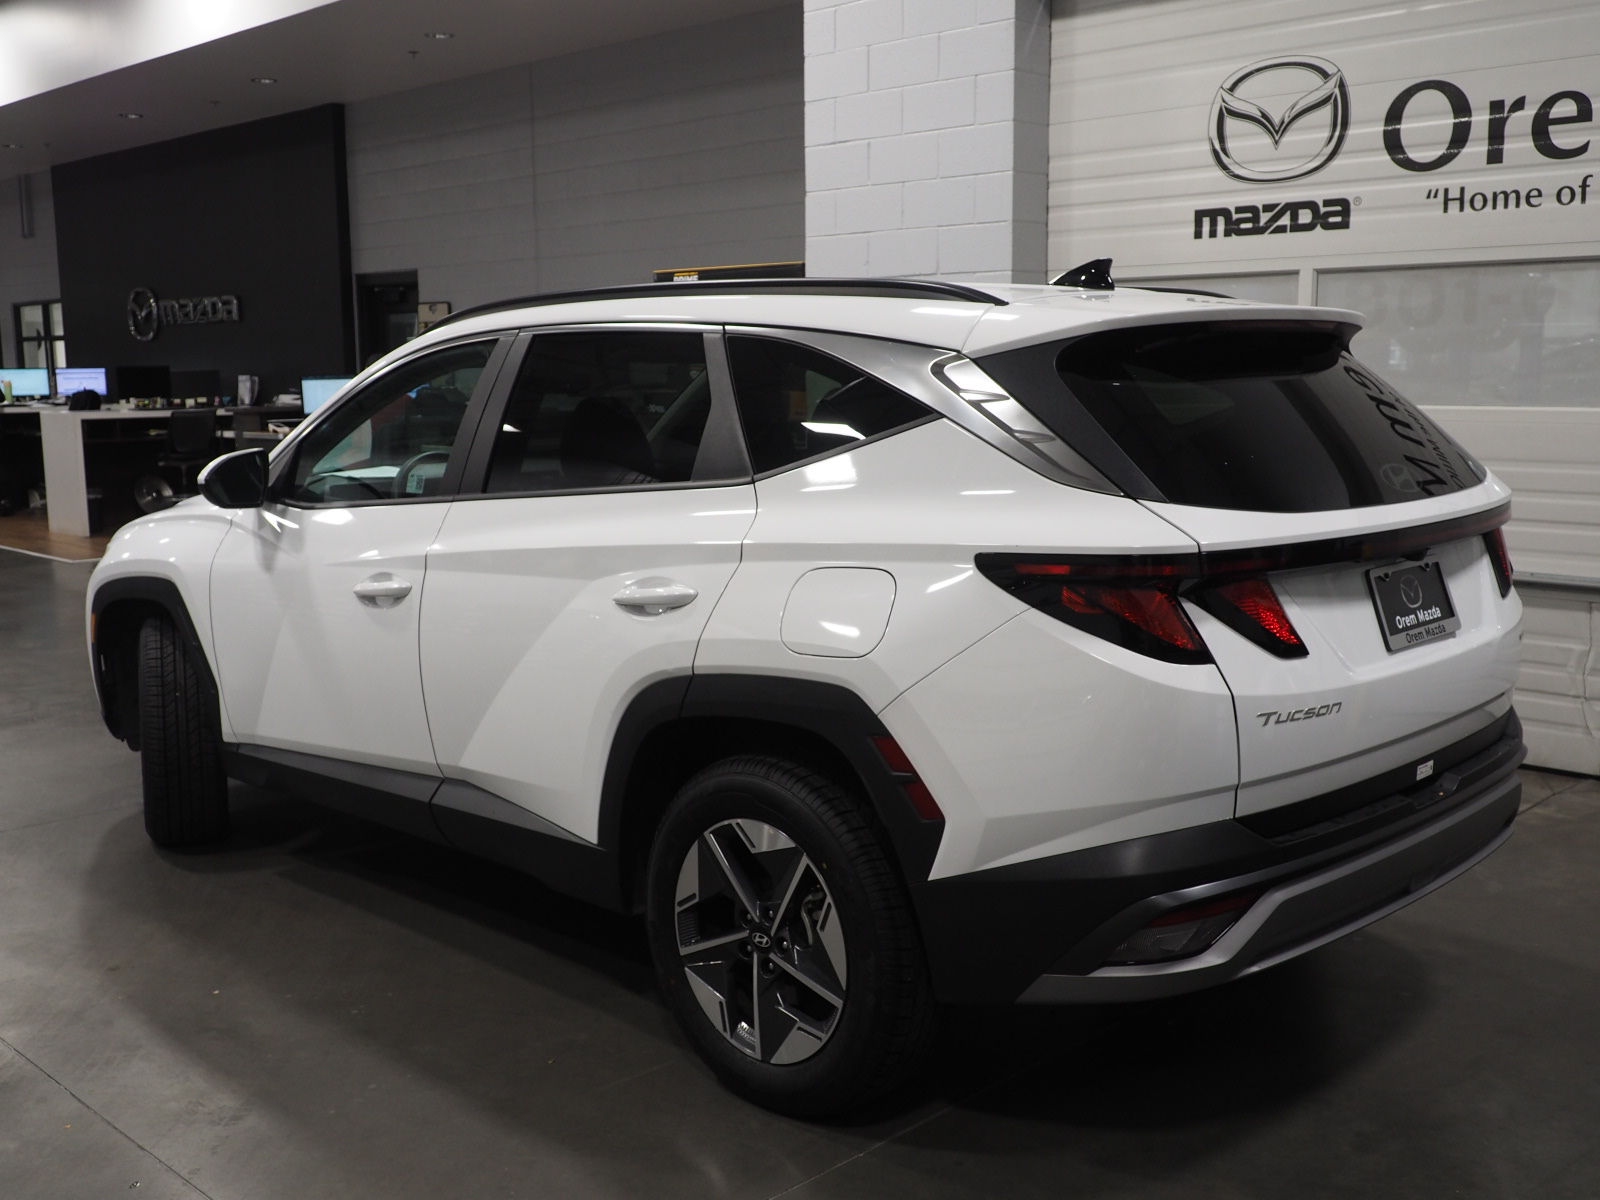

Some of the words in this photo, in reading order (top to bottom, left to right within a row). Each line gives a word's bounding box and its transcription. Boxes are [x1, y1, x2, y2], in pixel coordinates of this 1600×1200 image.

[1382, 79, 1594, 173] Ore
[1555, 174, 1594, 206] of
[1395, 613, 1417, 629] Orem
[1417, 605, 1441, 622] Mazda
[1406, 630, 1424, 643] Orem
[1425, 624, 1446, 638] Mazda
